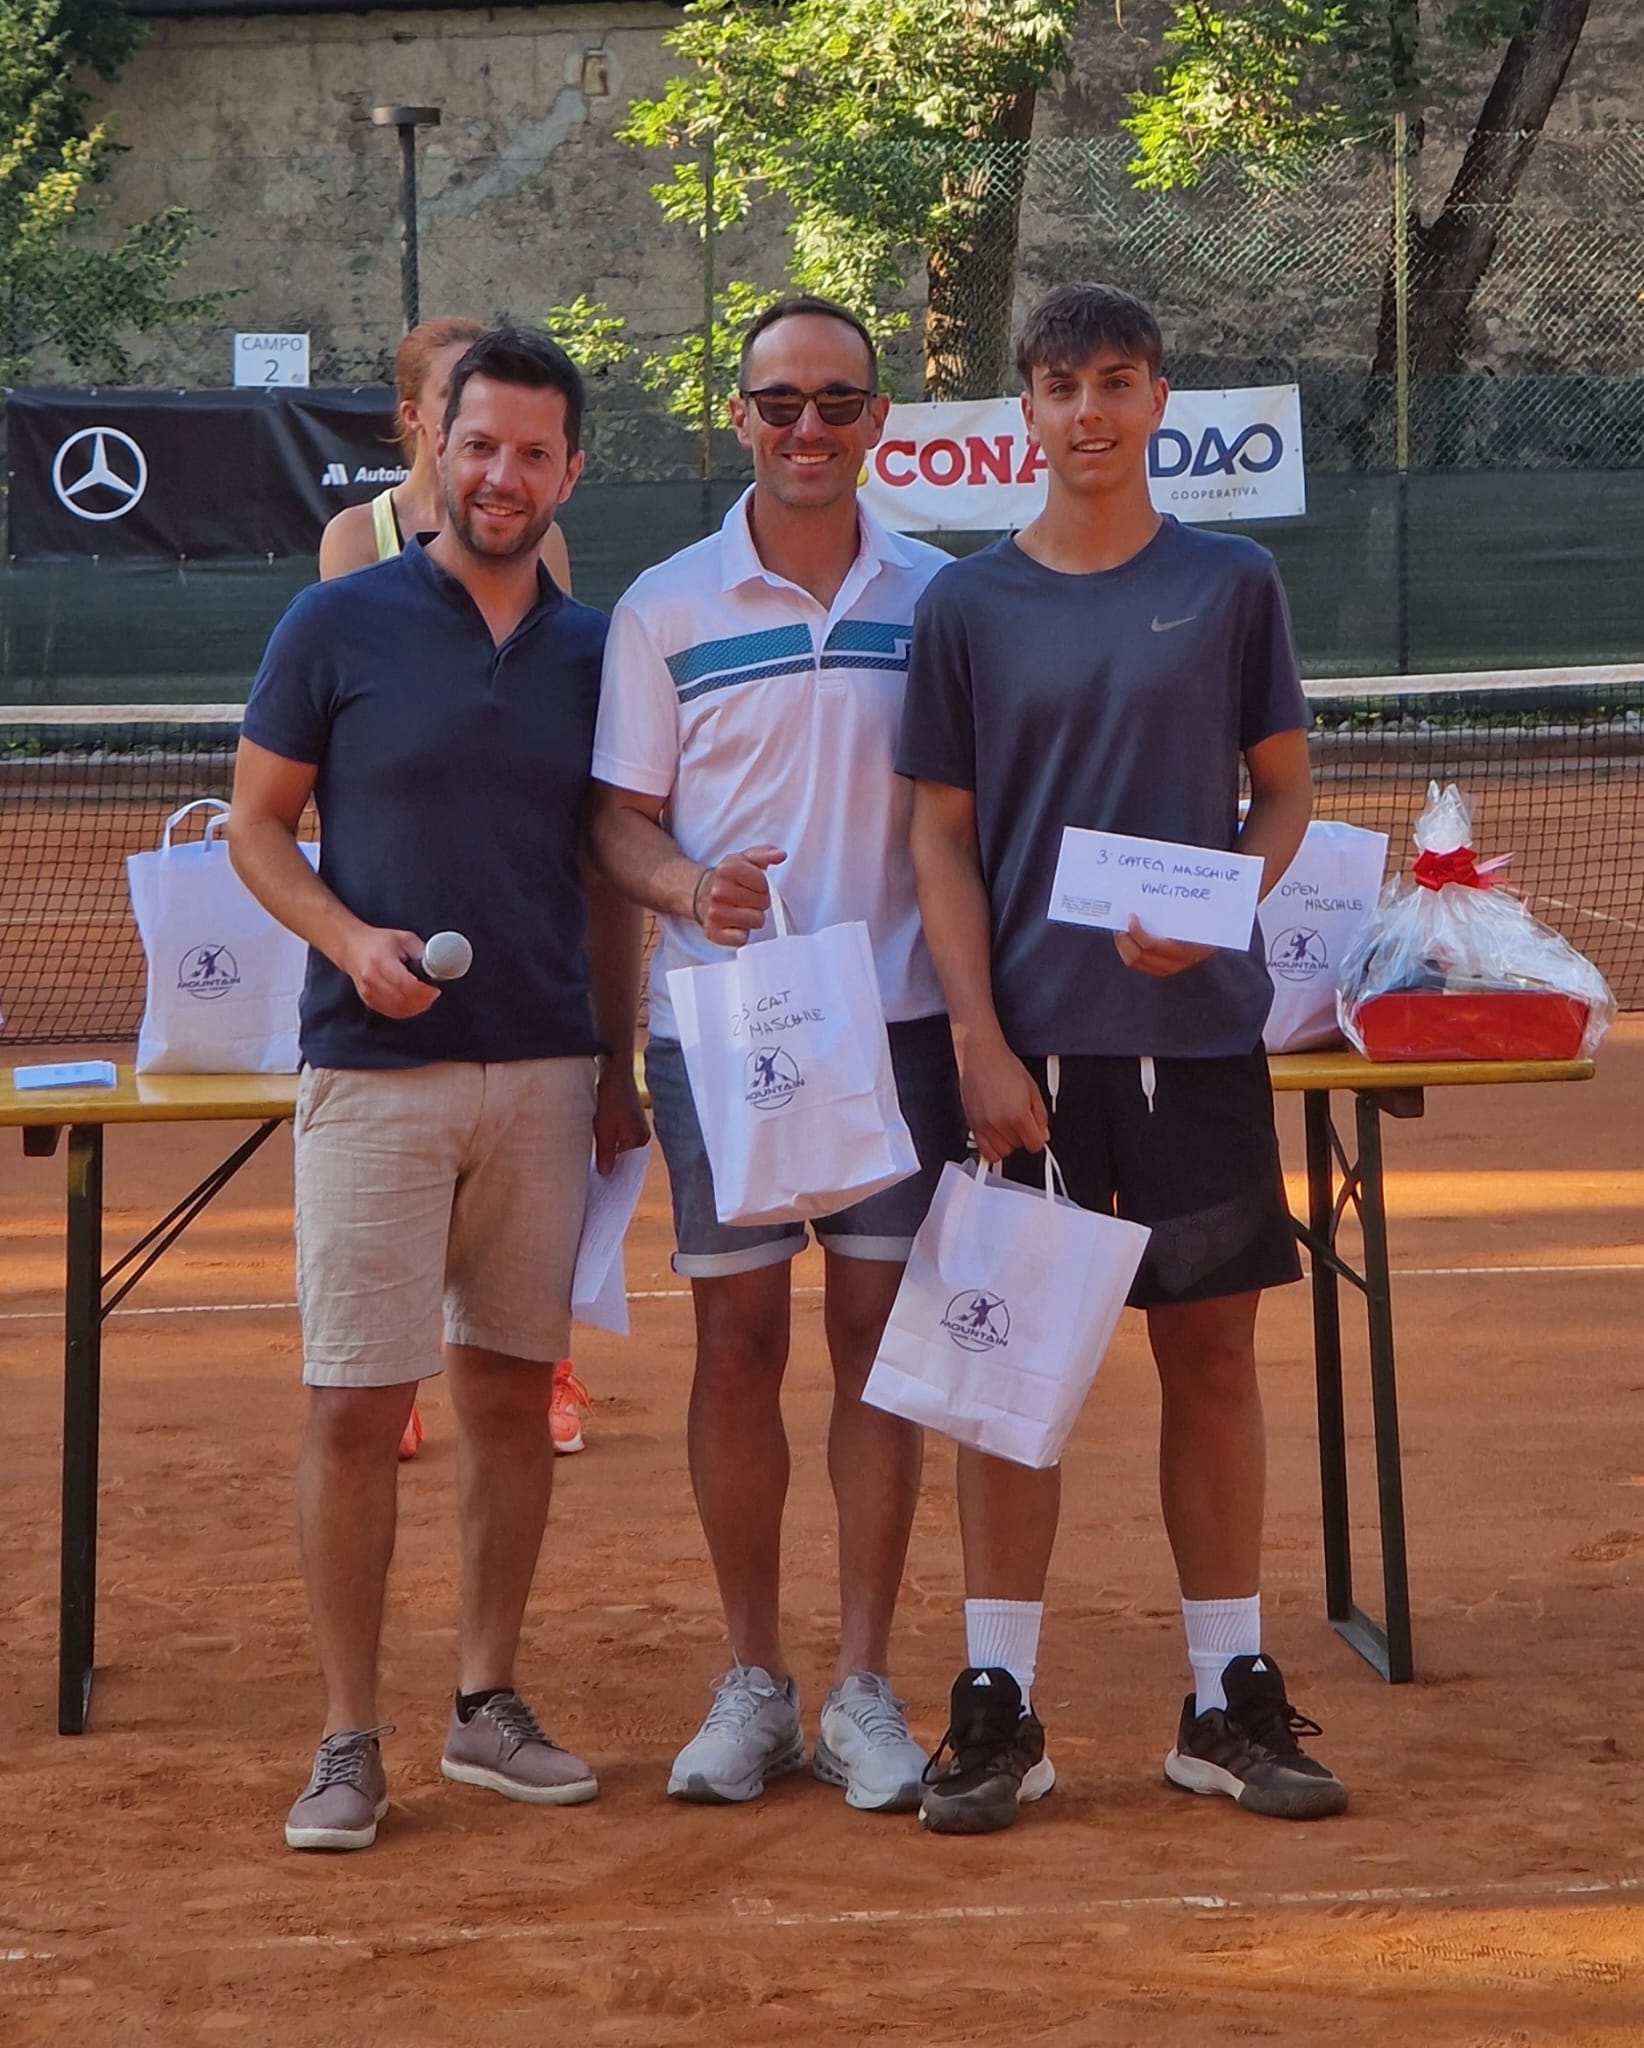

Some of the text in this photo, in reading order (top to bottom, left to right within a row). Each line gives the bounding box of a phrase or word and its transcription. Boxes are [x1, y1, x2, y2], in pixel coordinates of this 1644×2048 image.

[241, 337, 303, 351] CAMPO
[264, 359, 280, 383] 2
[1149, 423, 1283, 478] DAO
[1171, 486, 1258, 500] COOPERATIVA
[1141, 882, 1211, 901] VINCITORE
[1281, 881, 1319, 897] OPEN
[1267, 960, 1329, 970] MOUNTAIN
[177, 977, 240, 988] MOUNTAIN
[756, 990, 792, 1012] CAT
[940, 1320, 1008, 1346] MOUNTAIN
